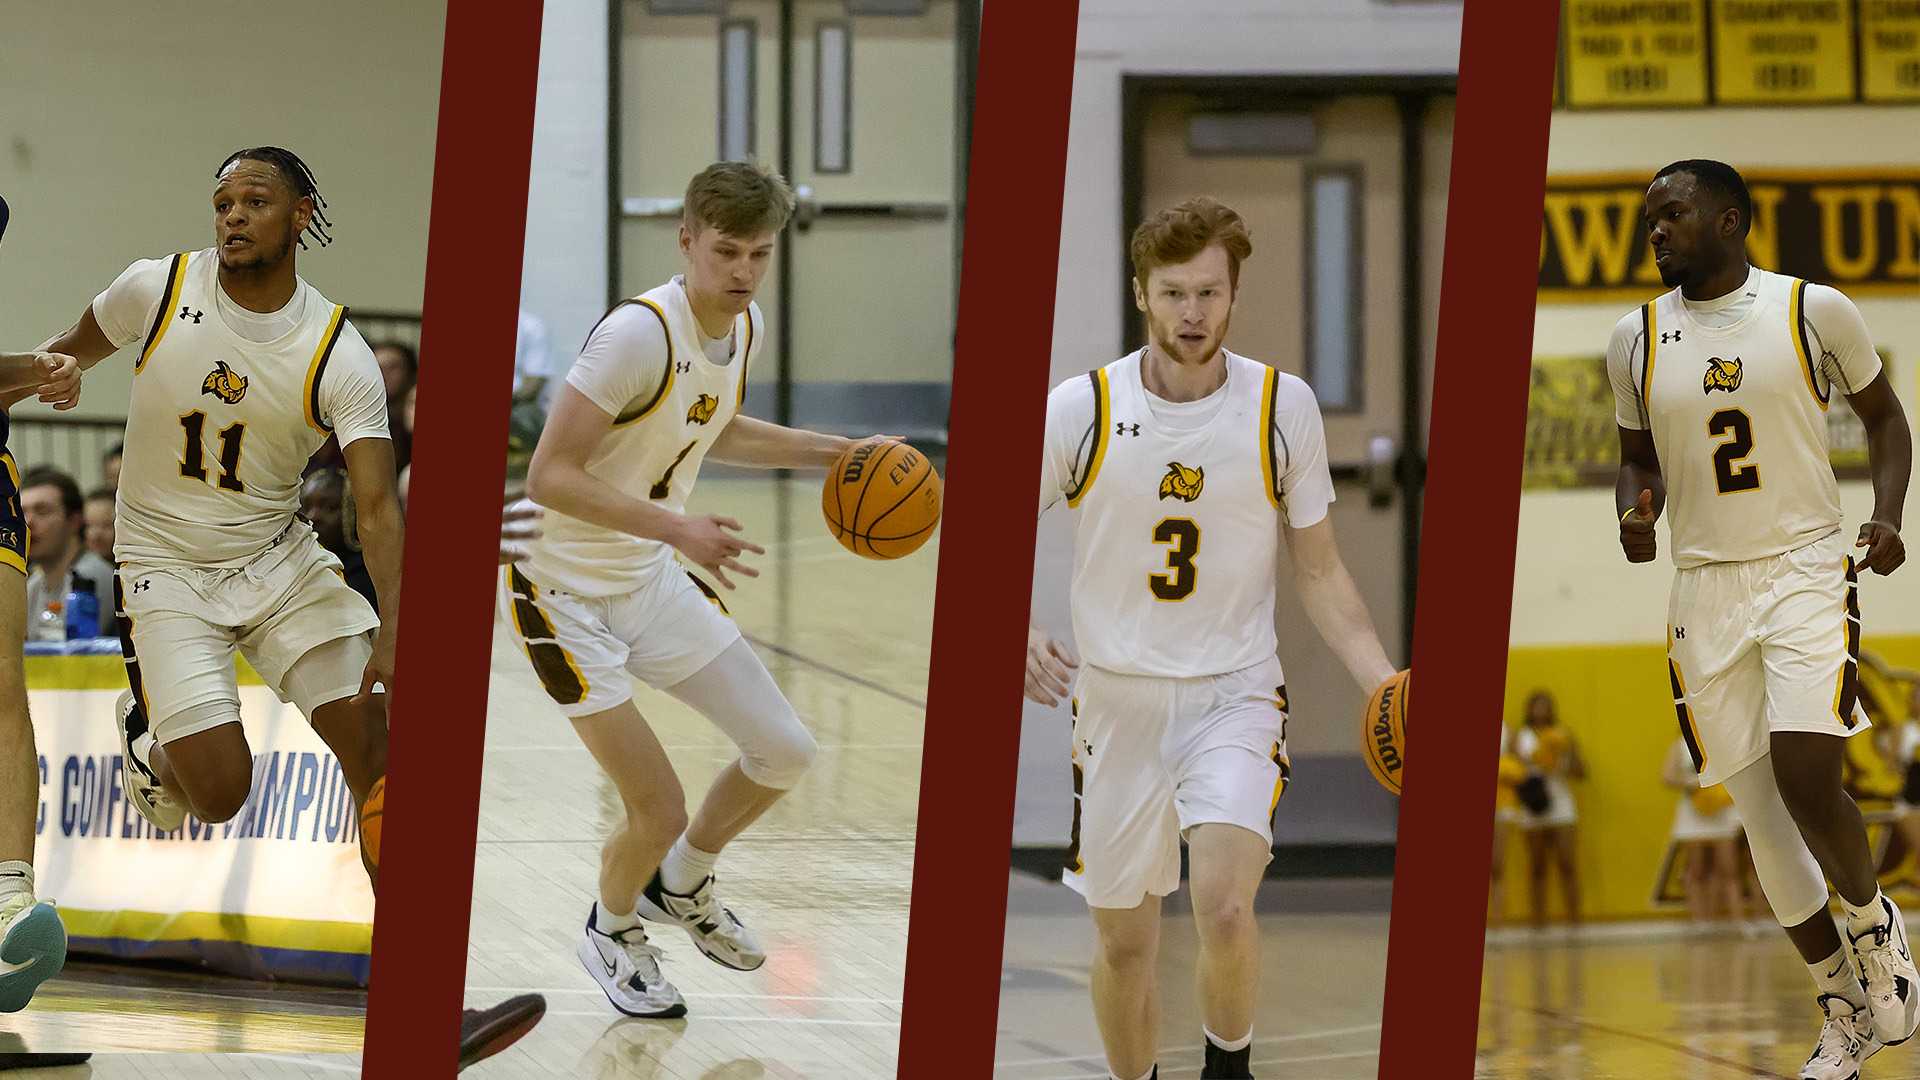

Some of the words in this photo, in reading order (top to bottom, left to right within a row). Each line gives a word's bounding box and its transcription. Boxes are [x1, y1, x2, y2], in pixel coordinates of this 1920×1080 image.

[177, 408, 247, 494] 11
[649, 439, 699, 500] 1
[889, 451, 918, 486] EVO
[1706, 406, 1762, 496] 2
[1148, 517, 1202, 602] 3
[1373, 684, 1402, 774] Wilson
